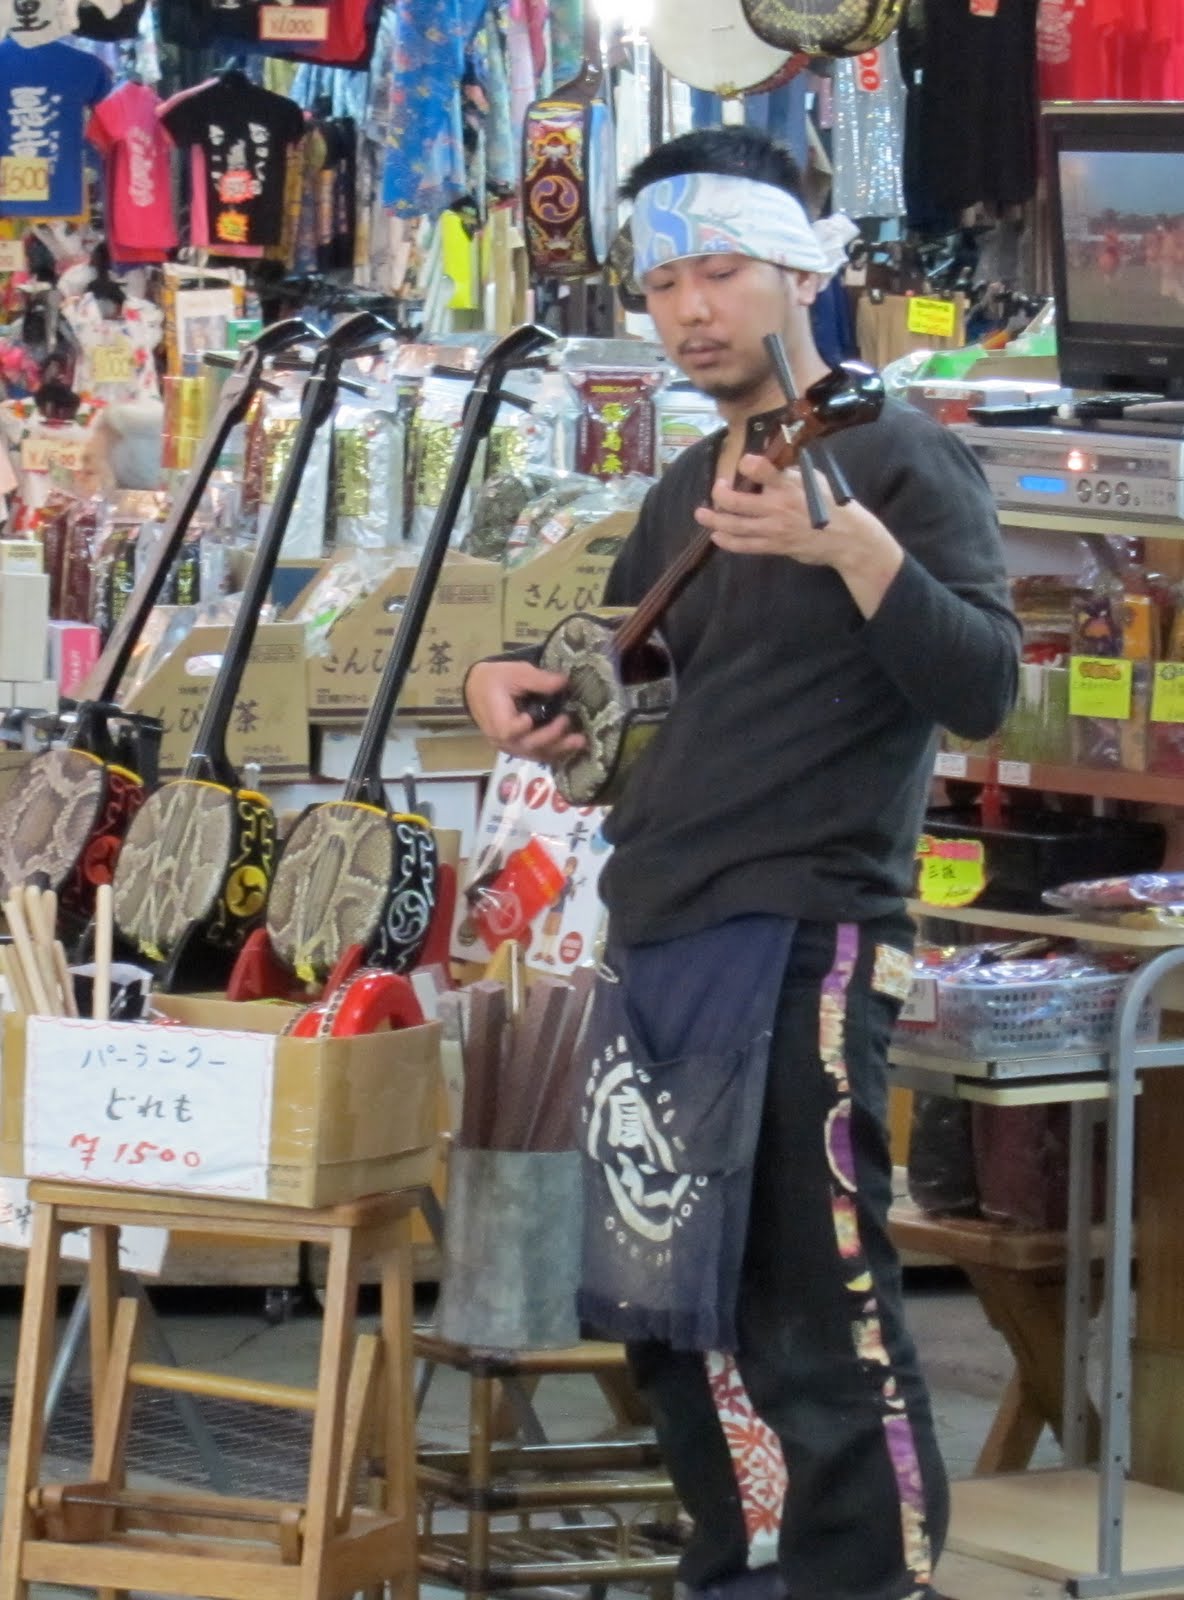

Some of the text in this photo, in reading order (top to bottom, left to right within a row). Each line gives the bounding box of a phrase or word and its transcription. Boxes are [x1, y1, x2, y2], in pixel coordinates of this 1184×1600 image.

[322, 641, 453, 675] さん茶
[105, 1088, 193, 1122] どれも
